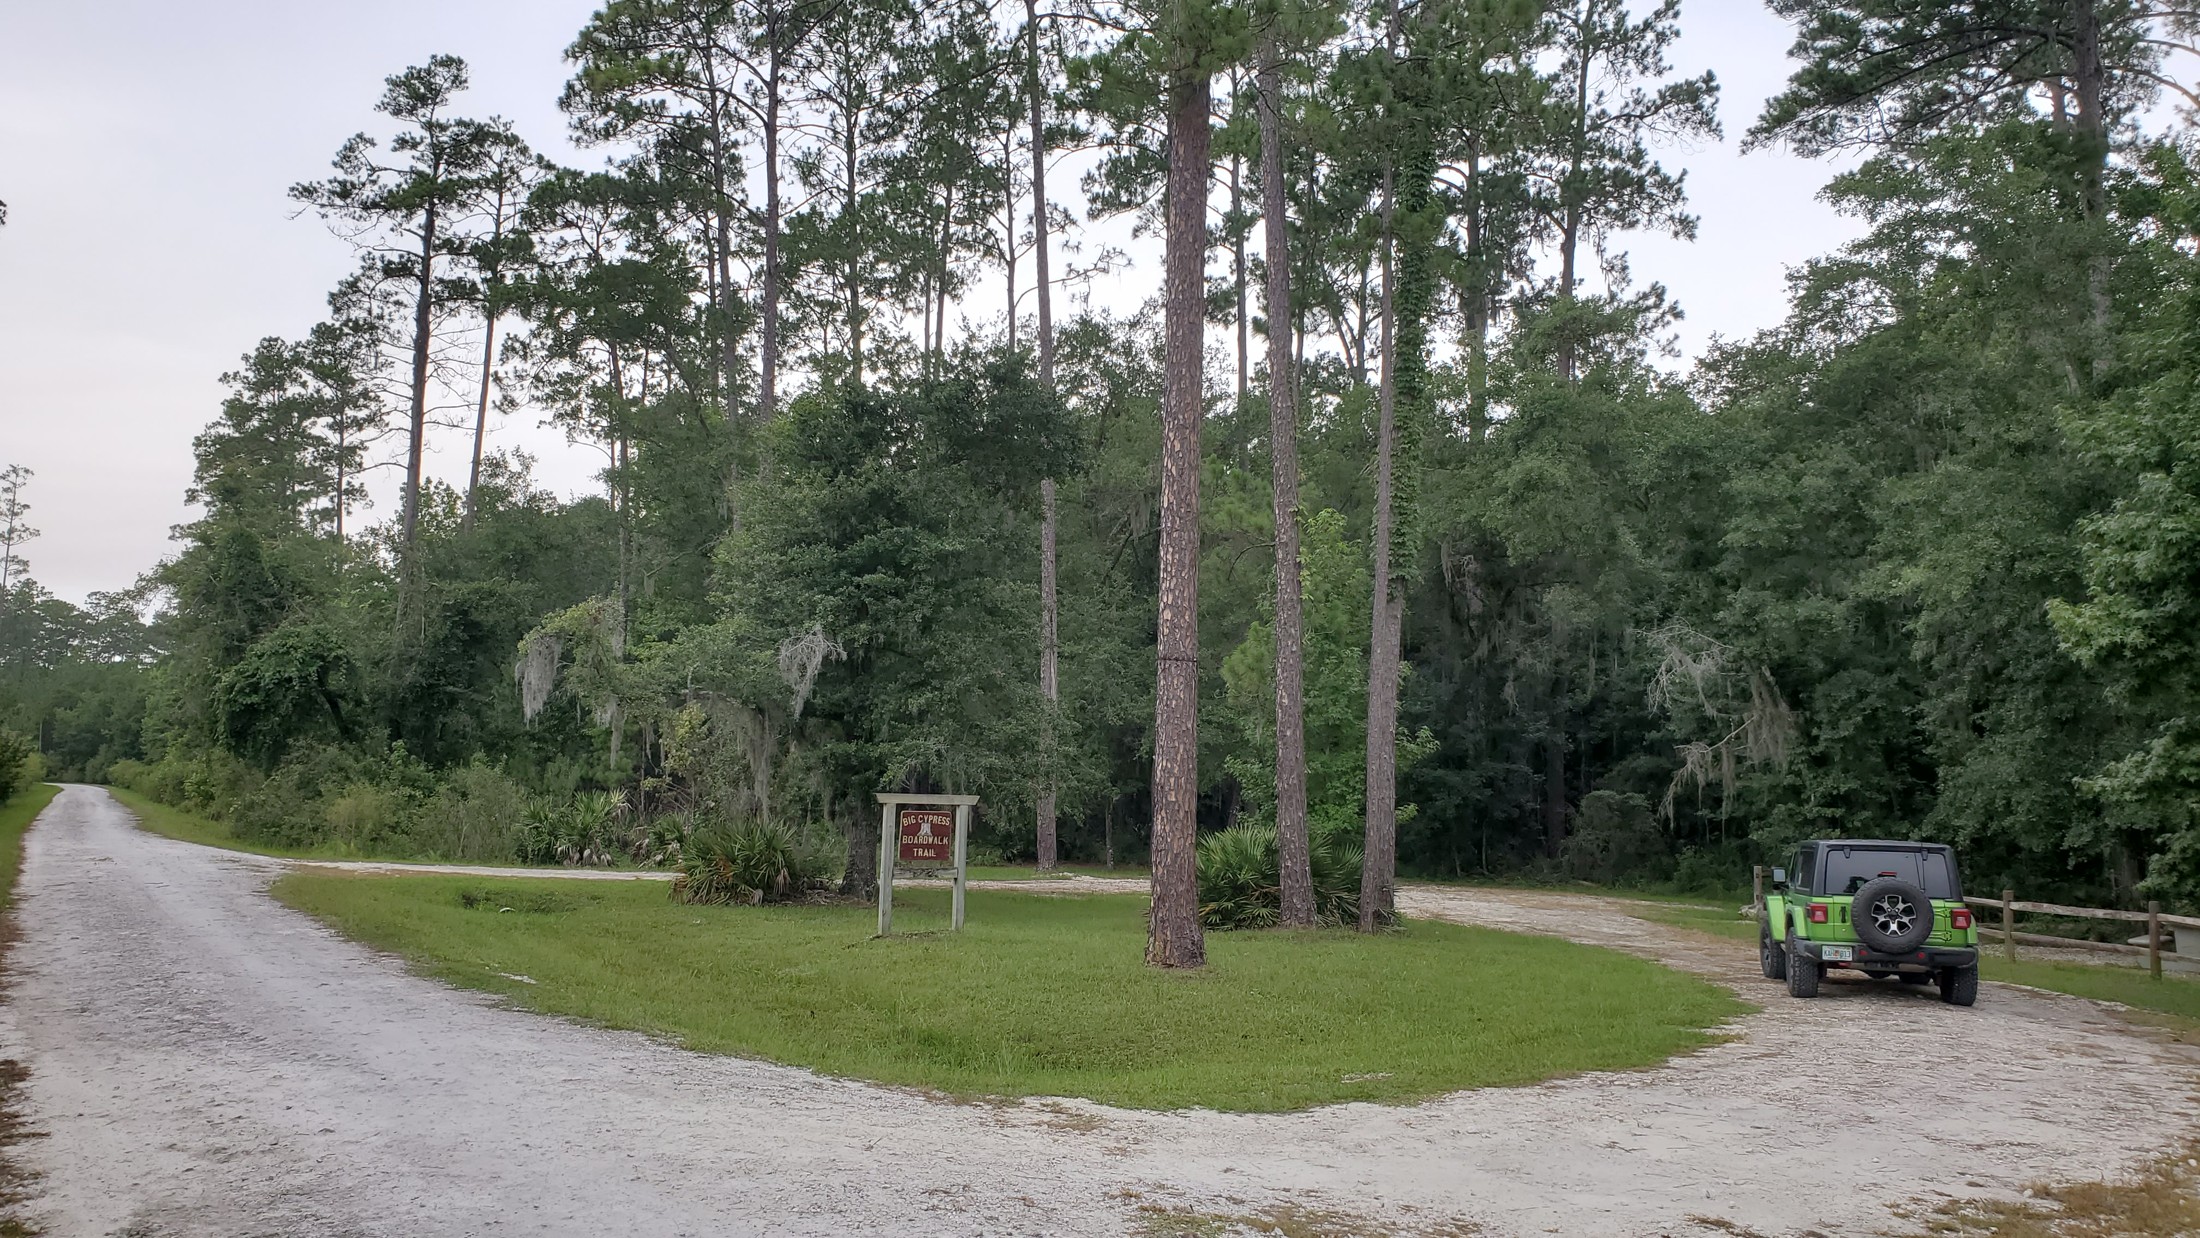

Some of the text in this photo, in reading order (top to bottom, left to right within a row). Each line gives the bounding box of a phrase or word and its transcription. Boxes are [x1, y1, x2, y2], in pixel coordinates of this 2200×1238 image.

[902, 814, 950, 826] BIG CYPRESS
[902, 836, 948, 845] BOARDWALK
[913, 848, 936, 857] TRAIL
